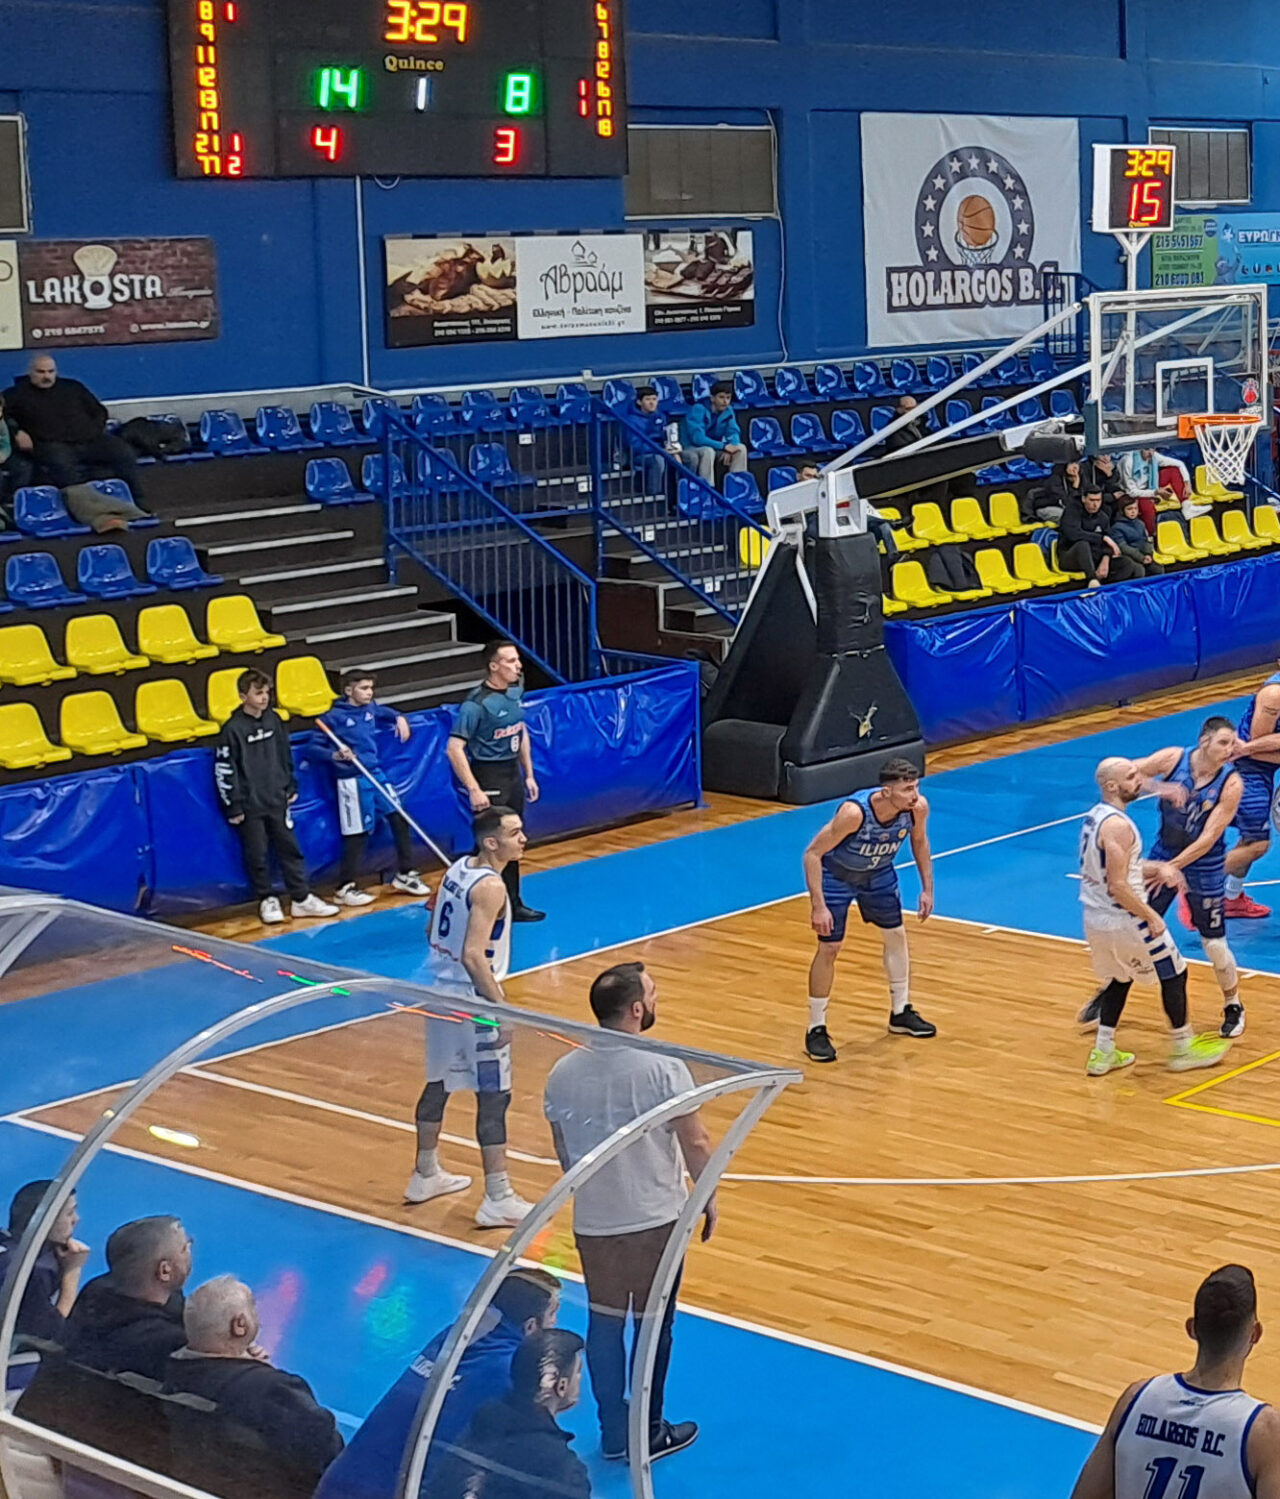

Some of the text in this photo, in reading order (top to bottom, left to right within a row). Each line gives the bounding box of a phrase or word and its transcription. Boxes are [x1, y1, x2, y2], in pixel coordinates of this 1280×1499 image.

[199, 0, 234, 20] 8 1
[384, 0, 467, 42] 3:29
[200, 23, 215, 42] 9
[197, 45, 216, 64] 11
[384, 55, 445, 72] Quince
[597, 41, 609, 59] 8
[319, 67, 531, 113] 14 1 8
[195, 132, 241, 153] 21 1
[314, 127, 516, 162] 4 3
[196, 154, 241, 175] 77 2
[1124, 149, 1172, 176] 3:29
[1129, 182, 1163, 222] 15
[26, 274, 164, 308] LAKOSTA
[539, 263, 623, 303] Αβραάμ
[888, 268, 1013, 307] HOLARGOS
[859, 841, 901, 856] ILION
[438, 900, 454, 938] 6
[1209, 909, 1222, 929] 5
[1135, 1413, 1199, 1449] HOLARGOS
[1142, 1456, 1205, 1499] 11
